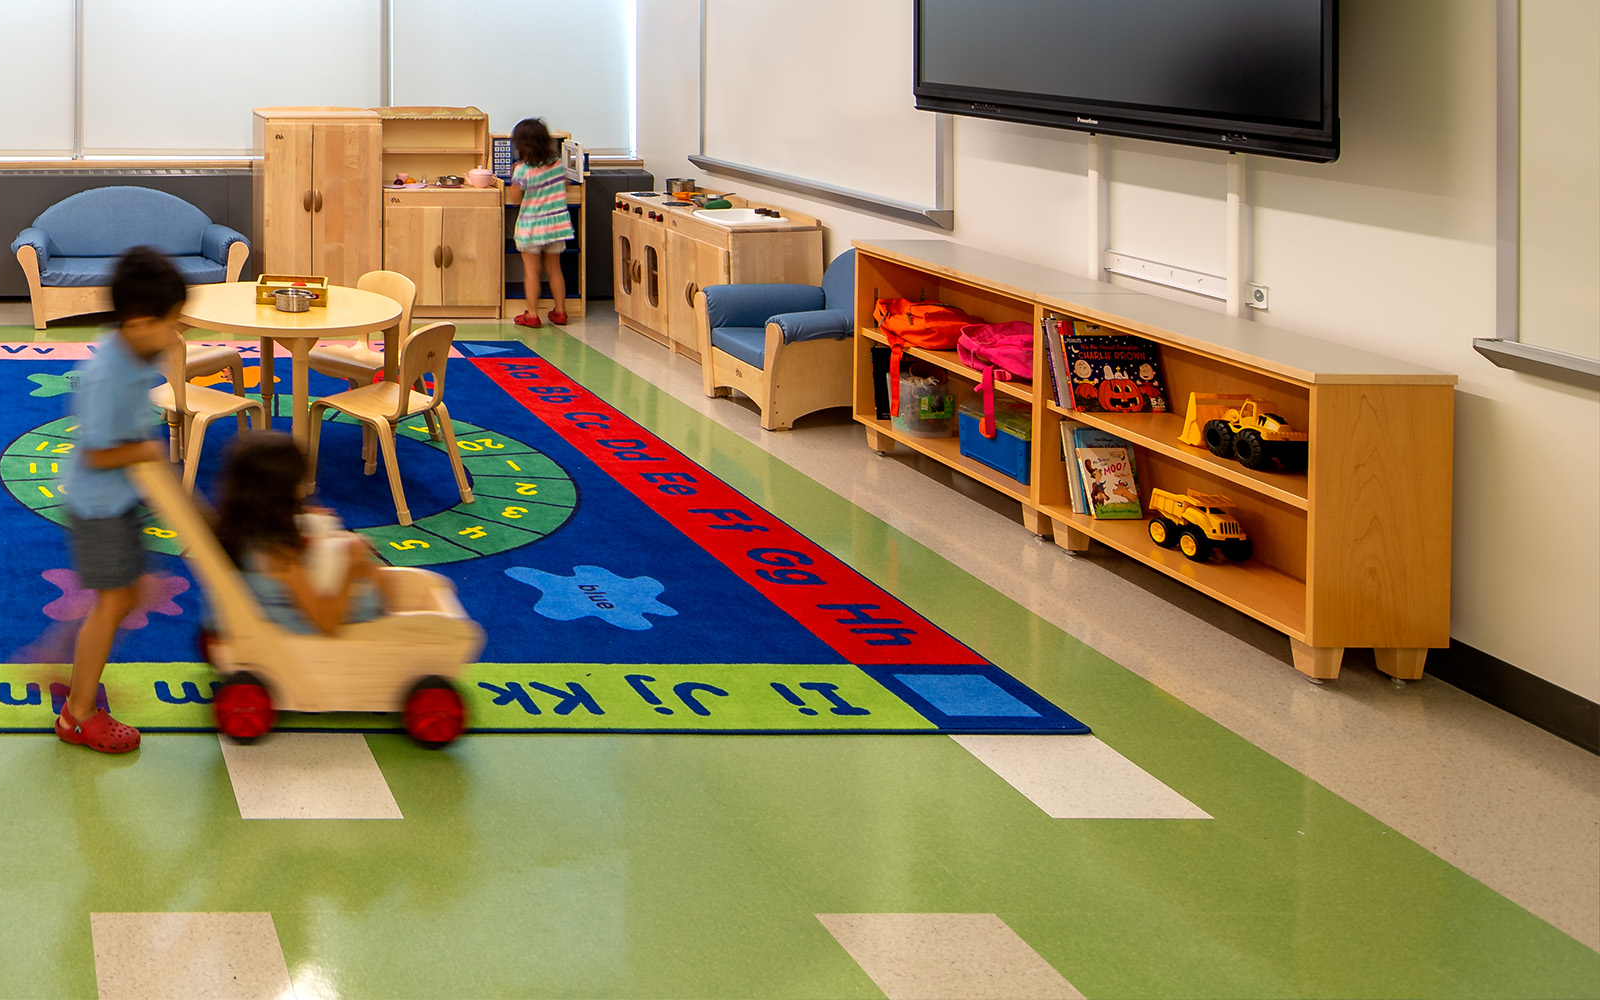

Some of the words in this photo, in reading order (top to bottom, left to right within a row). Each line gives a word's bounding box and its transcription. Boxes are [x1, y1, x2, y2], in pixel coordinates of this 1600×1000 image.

[1078, 350, 1112, 360] CHARLIE
[1114, 351, 1146, 361] BROWN
[497, 362, 542, 380] Aa
[526, 386, 581, 404] Bb
[562, 411, 611, 430] Cc
[35, 441, 75, 454] 12
[456, 438, 505, 452] 20
[595, 438, 668, 462] Dd
[29, 462, 59, 474] 11
[505, 459, 522, 472] 1
[1103, 462, 1127, 476] MOO!
[515, 482, 538, 496] 2
[639, 472, 699, 496] Ee
[501, 506, 529, 519] 3
[686, 508, 770, 533] Ff
[142, 527, 178, 539] 8
[458, 525, 488, 539] 4
[388, 539, 431, 551] 5
[746, 547, 828, 586] Gg
[578, 582, 615, 611] blue
[815, 603, 918, 647] Hh
[476, 680, 606, 717] Kk
[623, 674, 730, 717] Jj
[769, 681, 872, 717] Ii
